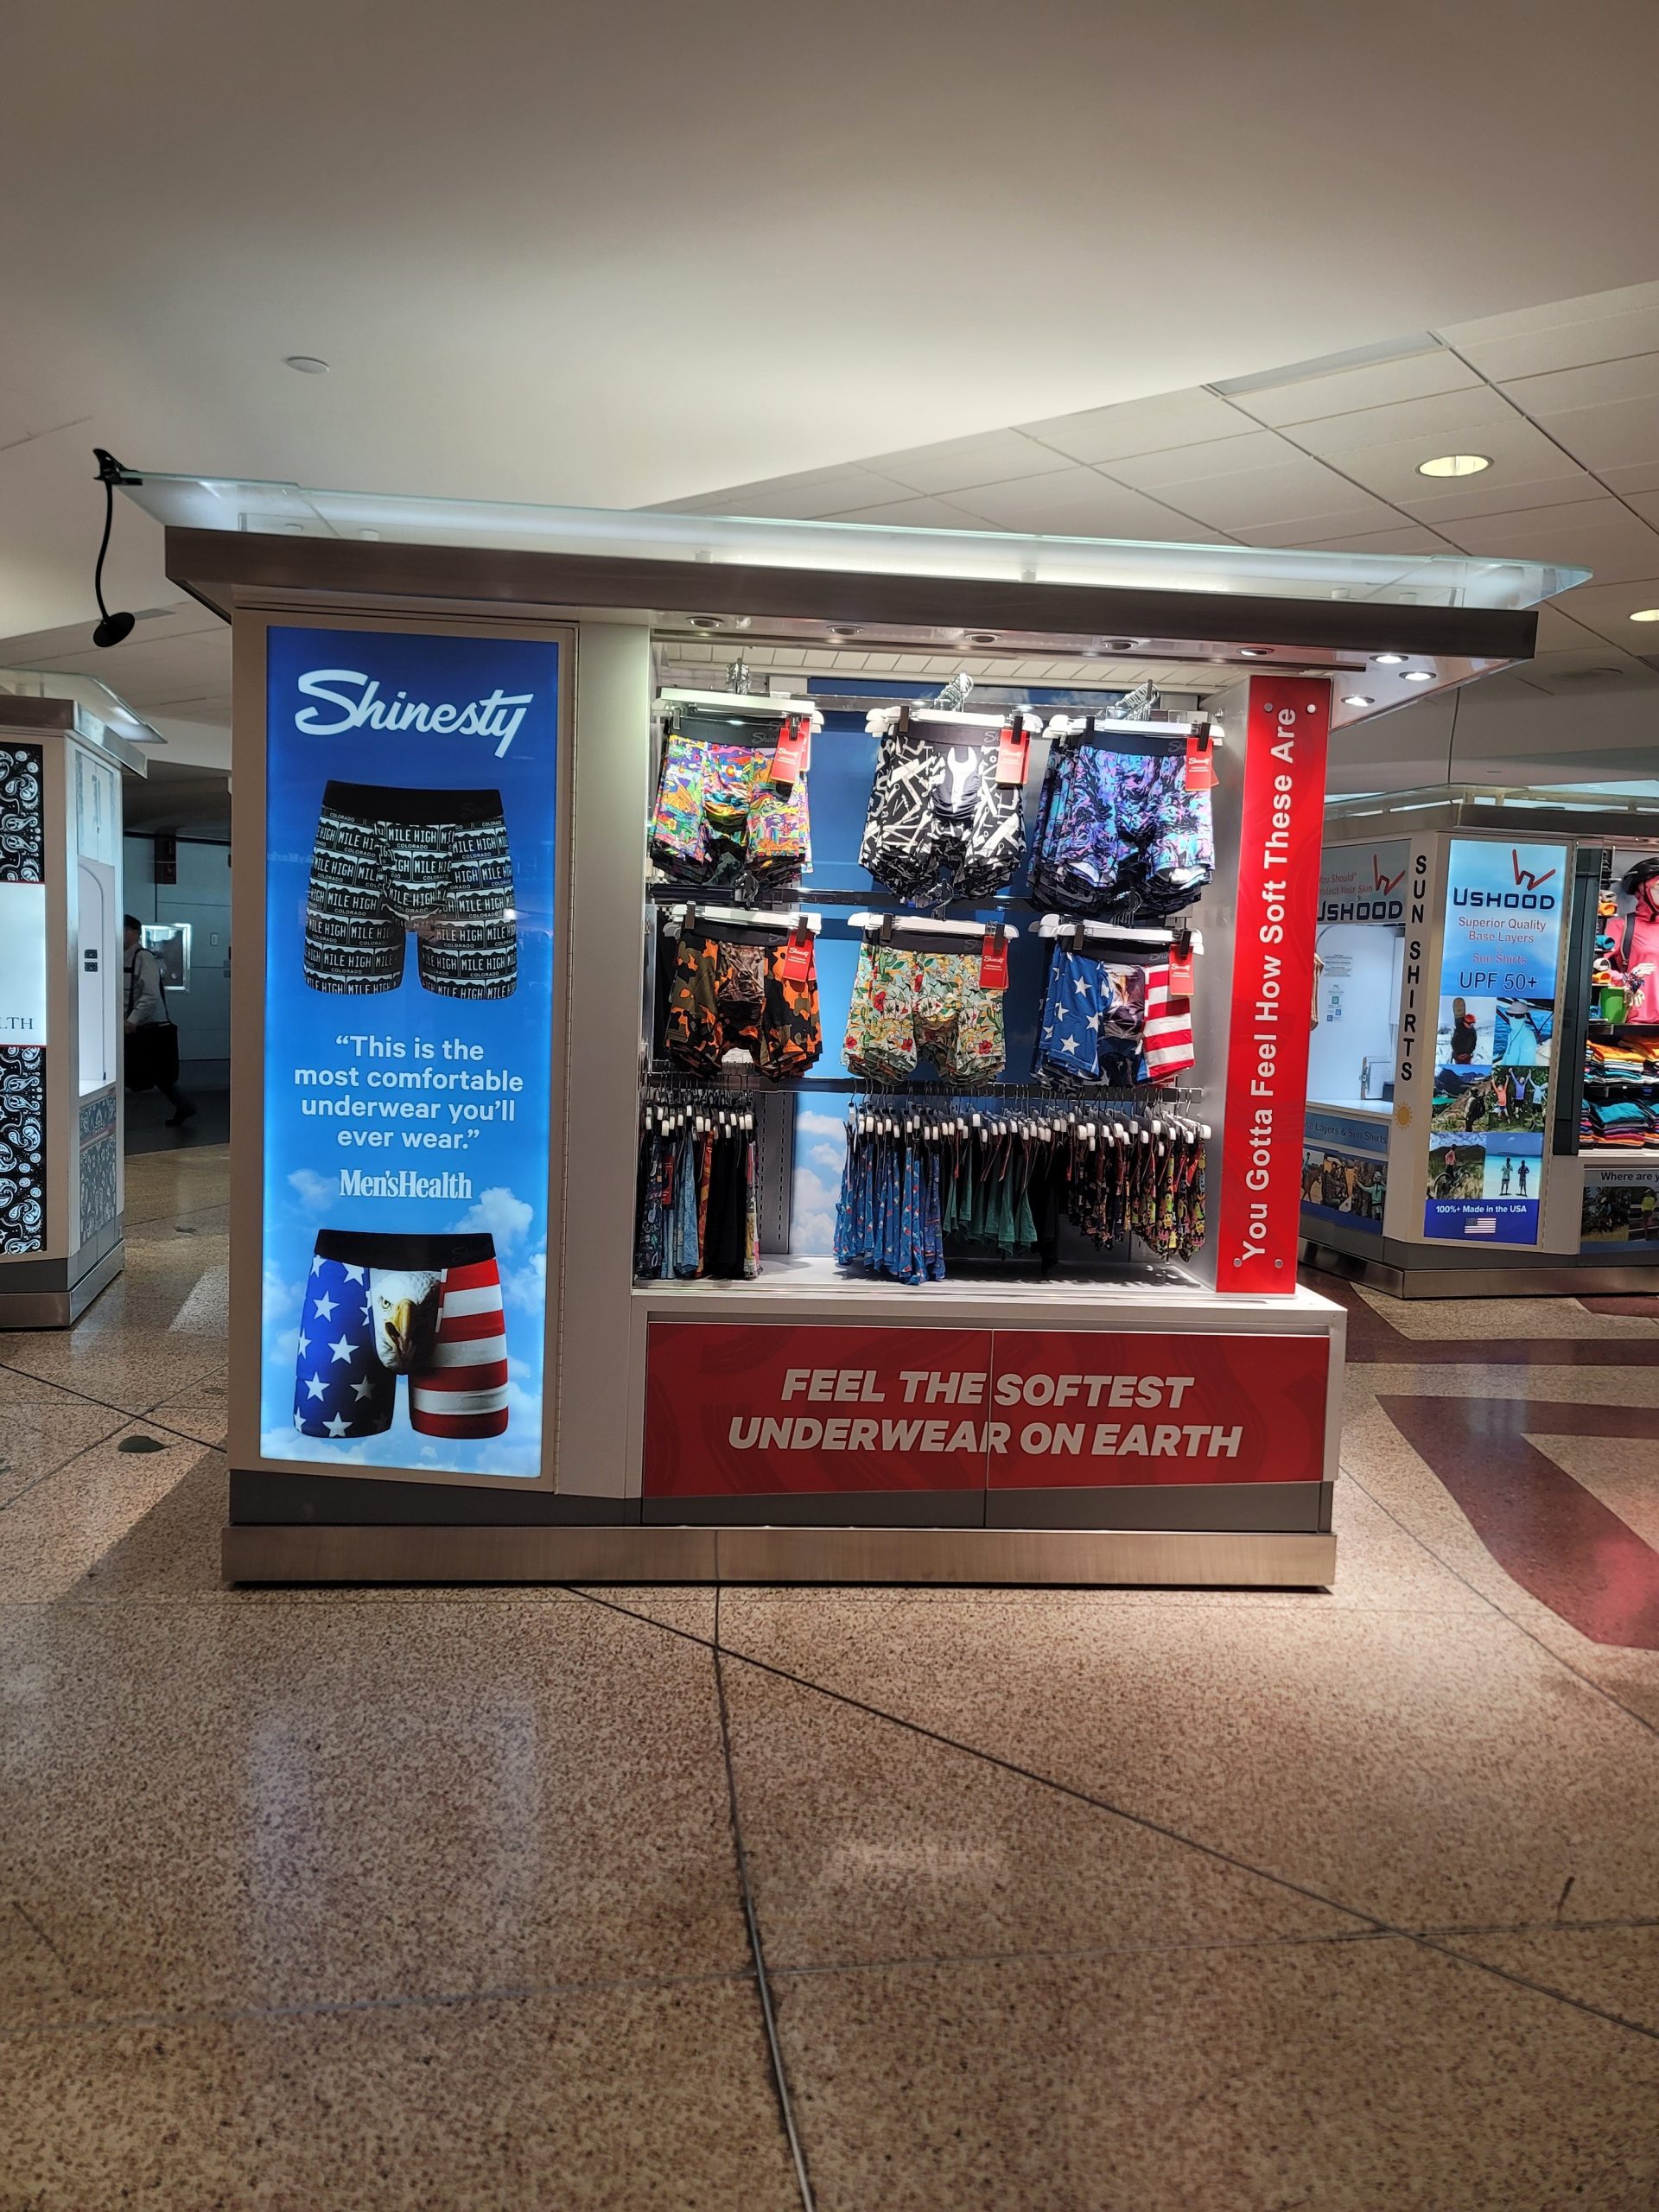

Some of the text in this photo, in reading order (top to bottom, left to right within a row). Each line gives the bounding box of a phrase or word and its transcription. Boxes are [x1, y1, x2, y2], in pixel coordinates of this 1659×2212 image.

[295, 670, 534, 758] Shinesty
[329, 812, 355, 822] COLORADO
[338, 831, 361, 848] MILE
[388, 829, 411, 842] MILE
[414, 830, 436, 842] HIGH
[344, 847, 376, 858] COLORADO
[453, 836, 497, 854] MILE HIGH
[331, 861, 354, 877] HIGH
[358, 866, 378, 881] MIL
[414, 860, 436, 874] MILE
[482, 866, 502, 880] MILE
[317, 873, 344, 883] COLORADO
[454, 868, 478, 883] HIGH
[390, 888, 410, 906] MILE
[1319, 884, 1373, 896] rotect Your Skin
[328, 892, 377, 911] MILE HIGH
[459, 896, 504, 912] MILE HIGH
[1453, 887, 1555, 910] USHOOD
[324, 923, 346, 938] HIGH
[1459, 916, 1546, 932] Superior Quality
[312, 934, 338, 943] COLORADO
[351, 925, 374, 939] MILE
[436, 929, 483, 941] MILE HIGH
[486, 926, 505, 938] MILE
[1469, 931, 1534, 944] Base Layers
[324, 952, 346, 966] MILE
[348, 956, 372, 968] HIGH
[376, 954, 393, 967] MILE
[436, 956, 457, 970] HIGH
[461, 957, 505, 971] MILE HIGH
[1472, 953, 1527, 964] Sun Shirts
[1401, 855, 1427, 1081] SUN SHIRTS
[1242, 708, 1296, 1261] You Gotta Feel How Soft These Are
[1459, 971, 1537, 990] UPF 50+
[461, 988, 483, 1000] HIGH
[486, 985, 505, 999] MILE
[335, 1035, 485, 1061] “This is the
[294, 1067, 524, 1092] most comfortable
[302, 1094, 515, 1124] underwear you’ll
[337, 1128, 480, 1149] ever wear.”
[1315, 1122, 1338, 1135] Layers
[1340, 1128, 1346, 1136] &
[1348, 1128, 1363, 1138] Sun
[1365, 1131, 1388, 1144] Shirts
[1600, 1172, 1634, 1181] Where
[1462, 1205, 1484, 1213] Made
[1486, 1205, 1494, 1213] in
[1496, 1205, 1508, 1213] the
[1510, 1205, 1527, 1213] USA
[780, 1368, 1196, 1408] FEEL THE SOFTEST
[728, 1415, 1243, 1459] UNDERWEAR ON EARTH
